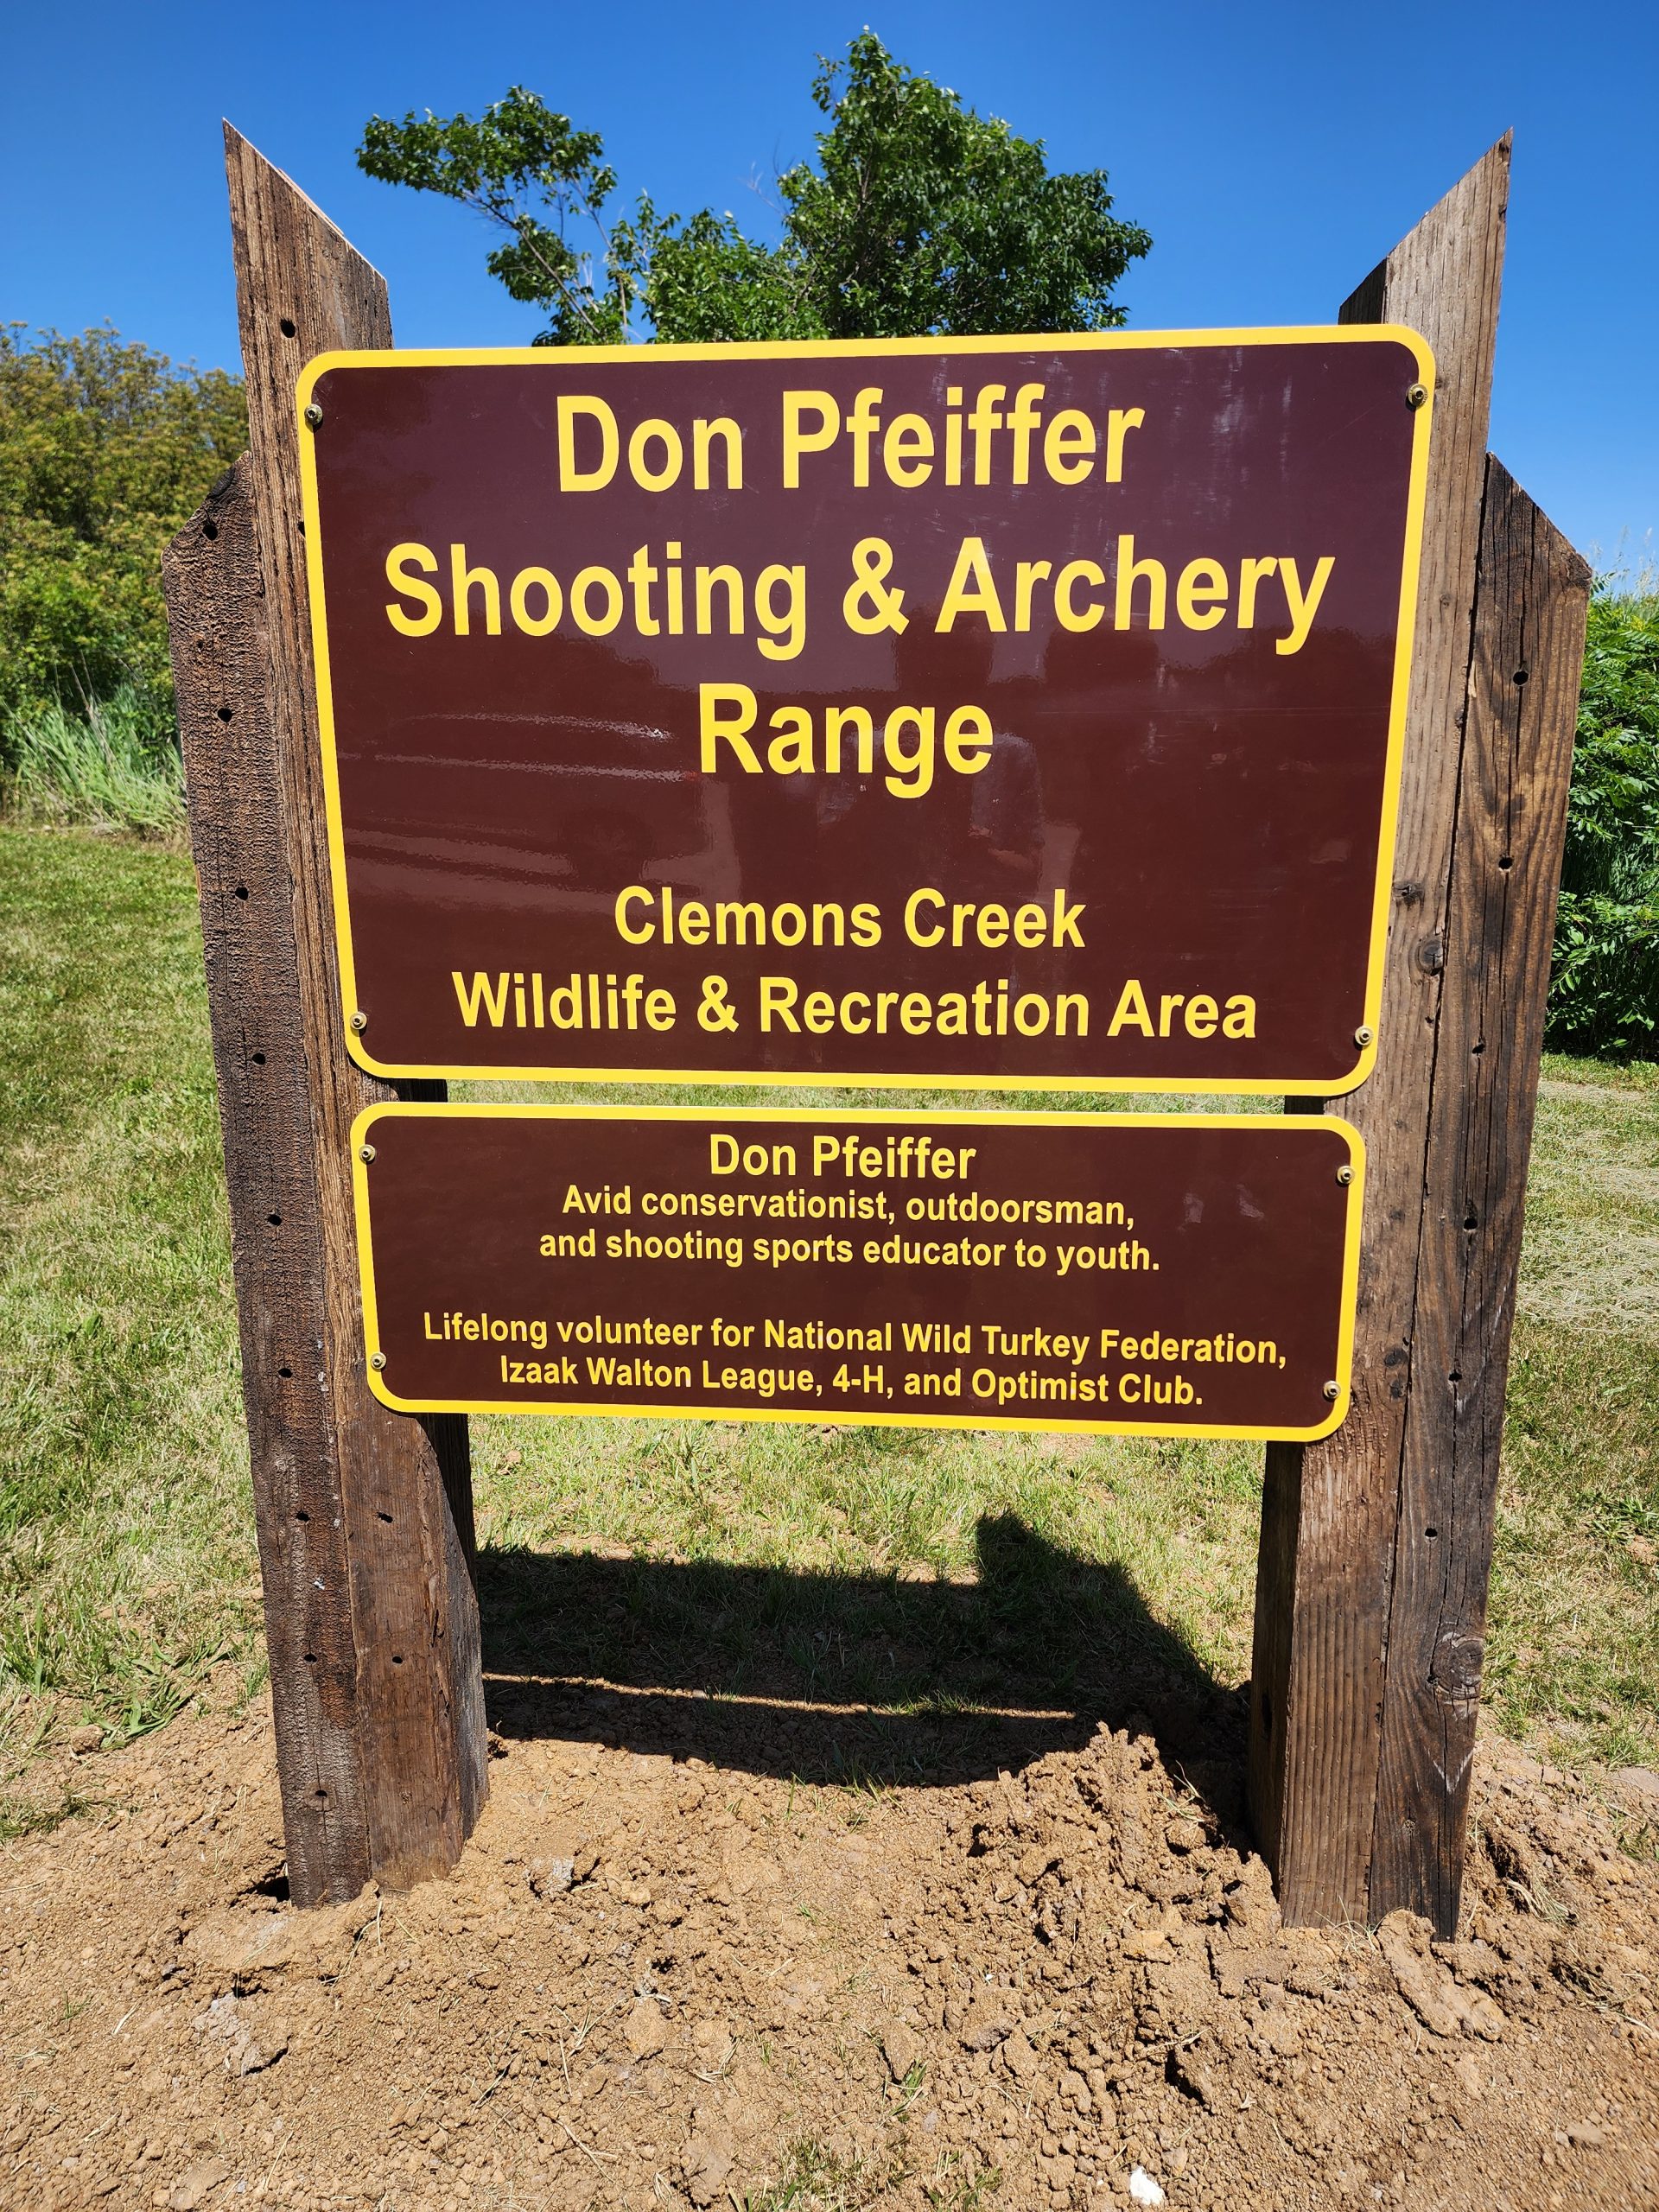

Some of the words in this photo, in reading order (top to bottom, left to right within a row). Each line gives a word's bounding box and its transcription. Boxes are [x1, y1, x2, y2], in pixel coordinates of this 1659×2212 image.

[557, 395, 743, 493] Don
[783, 383, 1145, 489] Pfeiffer
[385, 541, 806, 661] Shooting
[842, 537, 909, 635] &
[936, 535, 1335, 656] Archery
[699, 683, 994, 799] Range
[614, 886, 882, 948] Clemons
[904, 887, 1085, 949] Creek
[452, 971, 677, 1032] Wildlife
[696, 975, 739, 1033] &
[760, 976, 1090, 1037] Recreation
[1107, 980, 1255, 1039] Area
[709, 1133, 797, 1176] Don
[813, 1135, 976, 1179] Pfeiffer
[562, 1184, 632, 1215] Avid
[641, 1188, 895, 1224] conservationist,
[906, 1192, 1134, 1230] outdoorsman,
[539, 1229, 596, 1257] and
[606, 1230, 743, 1268] shooting
[753, 1235, 854, 1268] sports
[862, 1234, 1007, 1267] educator
[1014, 1239, 1047, 1268] to
[1056, 1240, 1159, 1276] youth.
[423, 1313, 548, 1350] Lifelong
[556, 1315, 703, 1346] volunteer
[710, 1317, 755, 1347] for
[764, 1319, 892, 1351] National
[901, 1323, 971, 1354] Wild
[981, 1325, 1090, 1366] Turkey
[1100, 1328, 1286, 1369] Federation,
[500, 1355, 578, 1384] Izaak
[586, 1357, 691, 1388] Walton
[702, 1359, 823, 1398] League,
[832, 1363, 893, 1397] 4-H,
[904, 1368, 962, 1397] and
[971, 1368, 1109, 1405] Optimist
[1118, 1373, 1203, 1405] Club.
